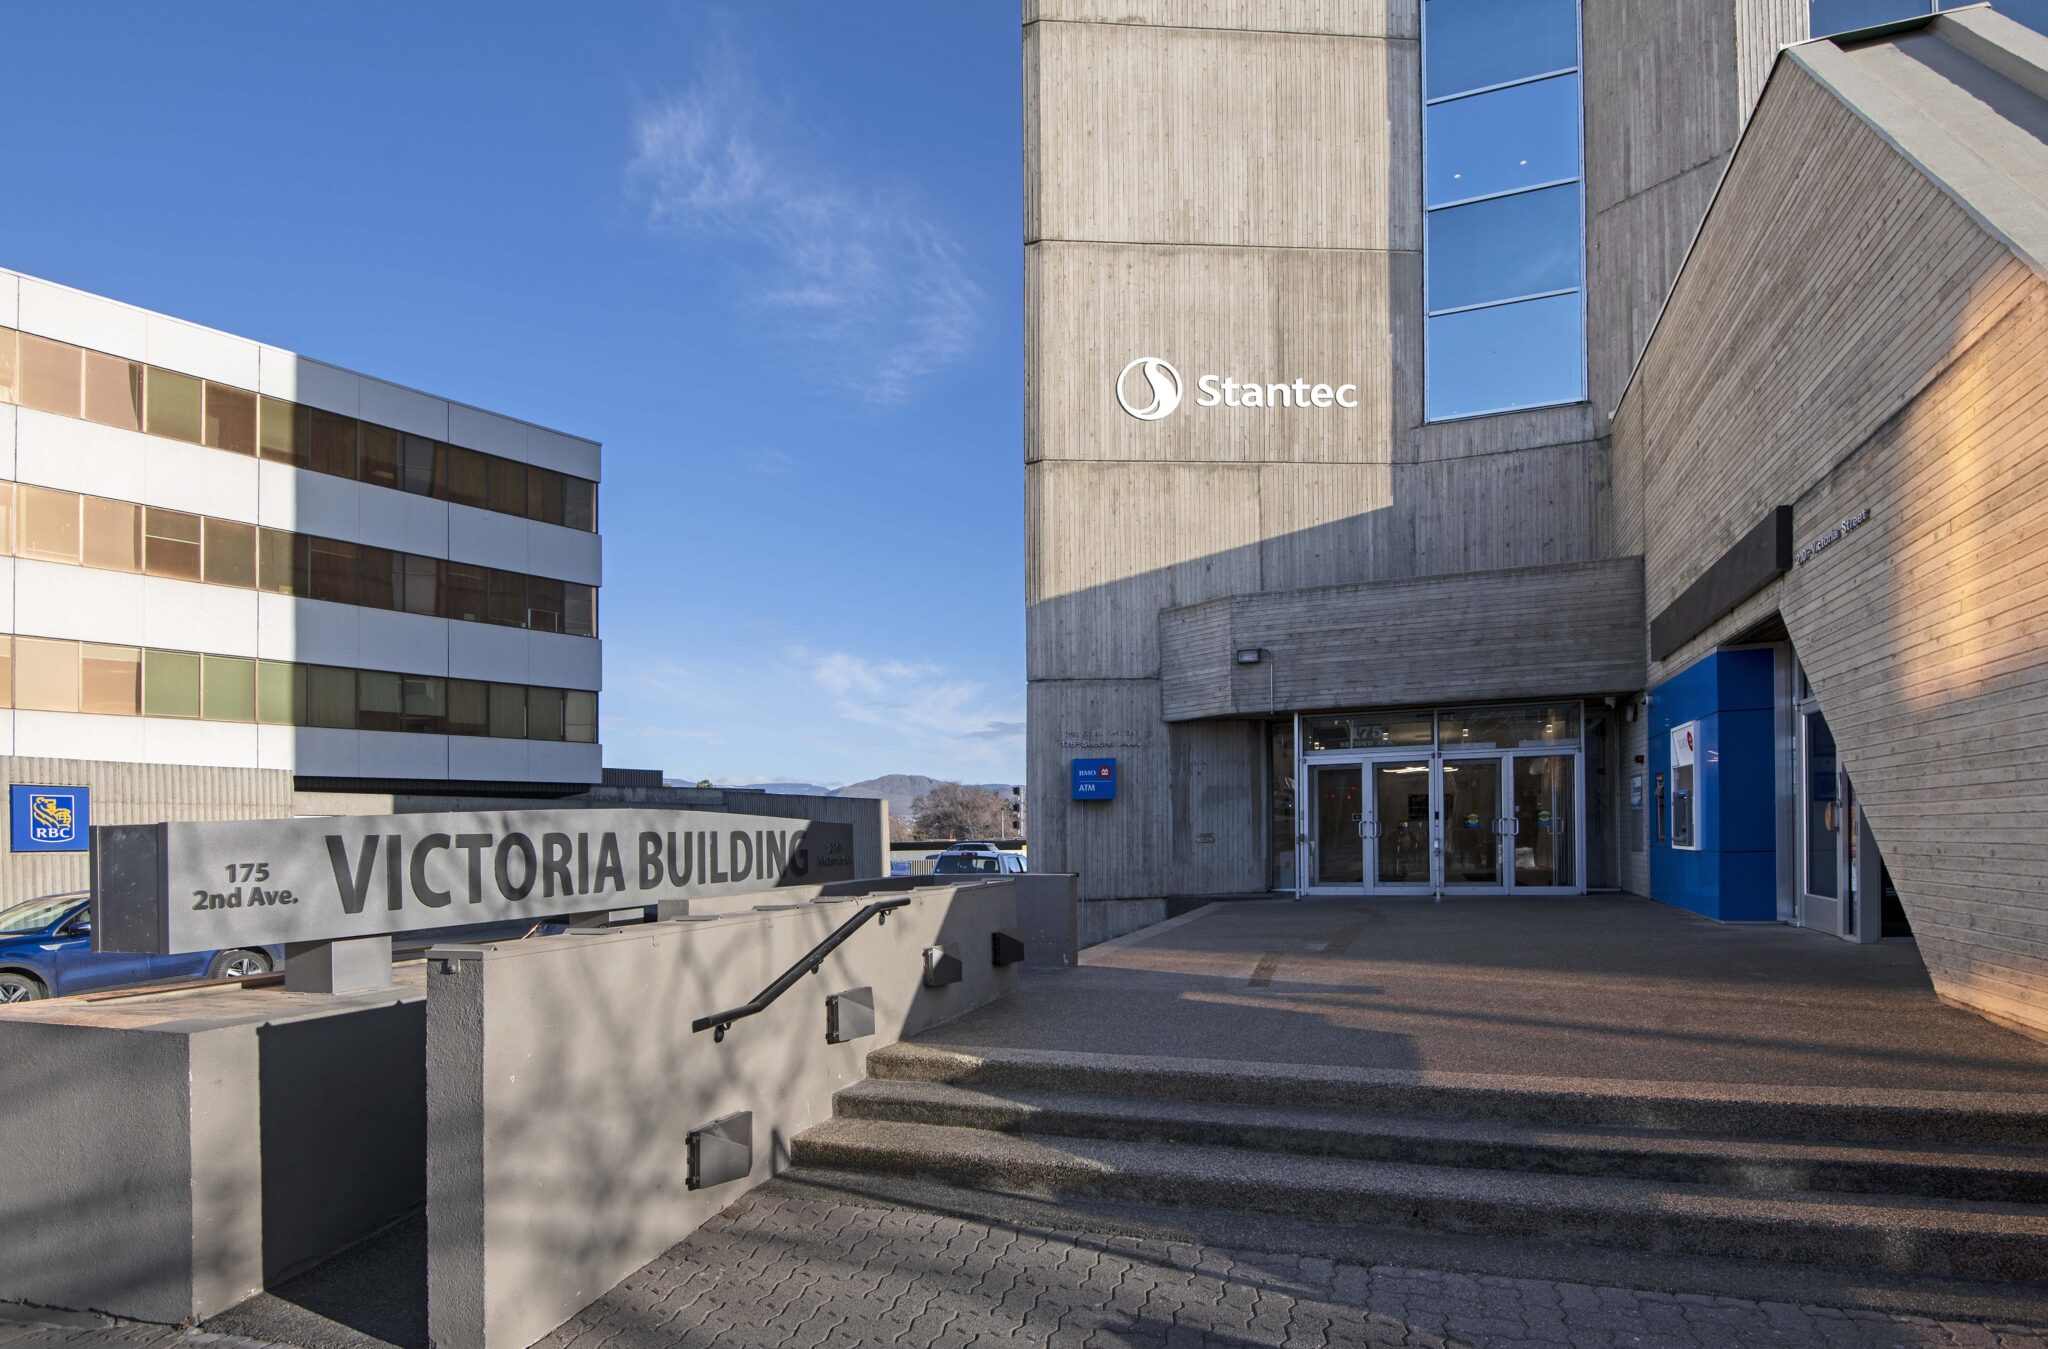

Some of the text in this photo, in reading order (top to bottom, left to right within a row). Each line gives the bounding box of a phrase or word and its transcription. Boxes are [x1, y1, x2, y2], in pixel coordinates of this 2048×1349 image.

[1196, 374, 1358, 408] Stantec
[1841, 509, 1868, 533] Street
[1078, 784, 1096, 792] ATM
[36, 828, 71, 838] RBC
[225, 862, 270, 883] 175
[325, 829, 809, 914] VICTORIA BUILDING
[192, 887, 298, 910] 2nd Ave.
